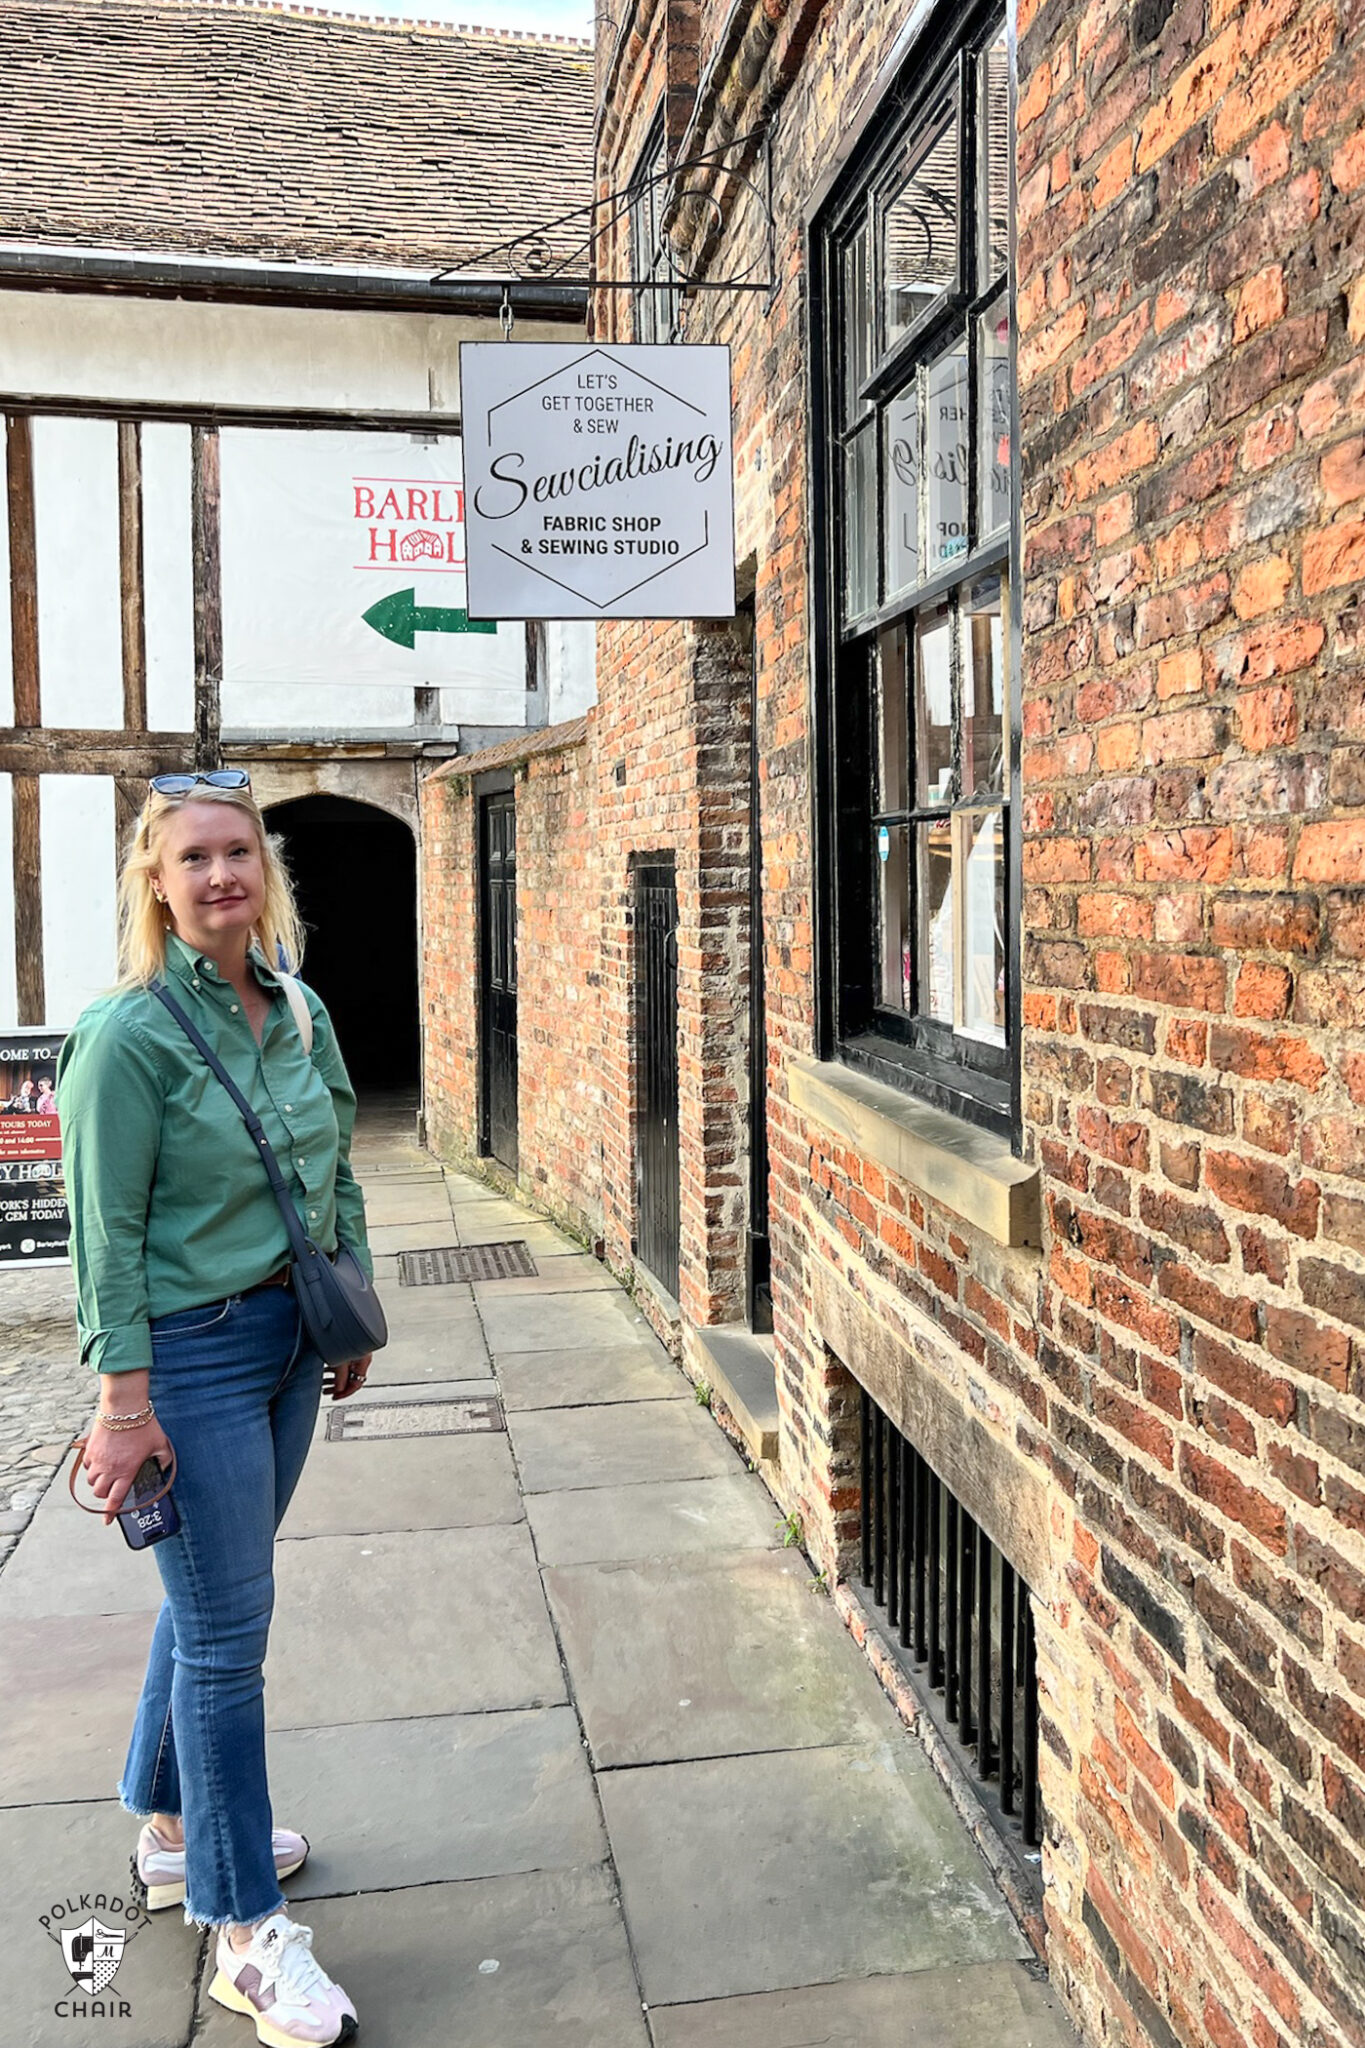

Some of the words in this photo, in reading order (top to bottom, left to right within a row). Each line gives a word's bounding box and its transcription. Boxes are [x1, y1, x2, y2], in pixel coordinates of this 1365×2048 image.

[577, 374, 618, 389] LET'S
[541, 396, 571, 411] GET
[574, 397, 654, 412] TOGETHER
[573, 419, 583, 433] &
[587, 419, 619, 433] SEW
[473, 434, 723, 519] Sewcialising
[543, 516, 607, 532] FABRIC
[612, 517, 661, 532] SHOP
[520, 539, 533, 554] &
[538, 539, 608, 555] SEWING
[611, 540, 680, 555] STUDIO
[1, 1120, 26, 1129] TOURS
[27, 1120, 52, 1128] TODAY
[0, 1164, 14, 1180] Y
[0, 1199, 29, 1211] ORK'S
[5, 1211, 28, 1222] GEM
[30, 1209, 65, 1220] TODAY
[137, 1510, 162, 1529] 3:28
